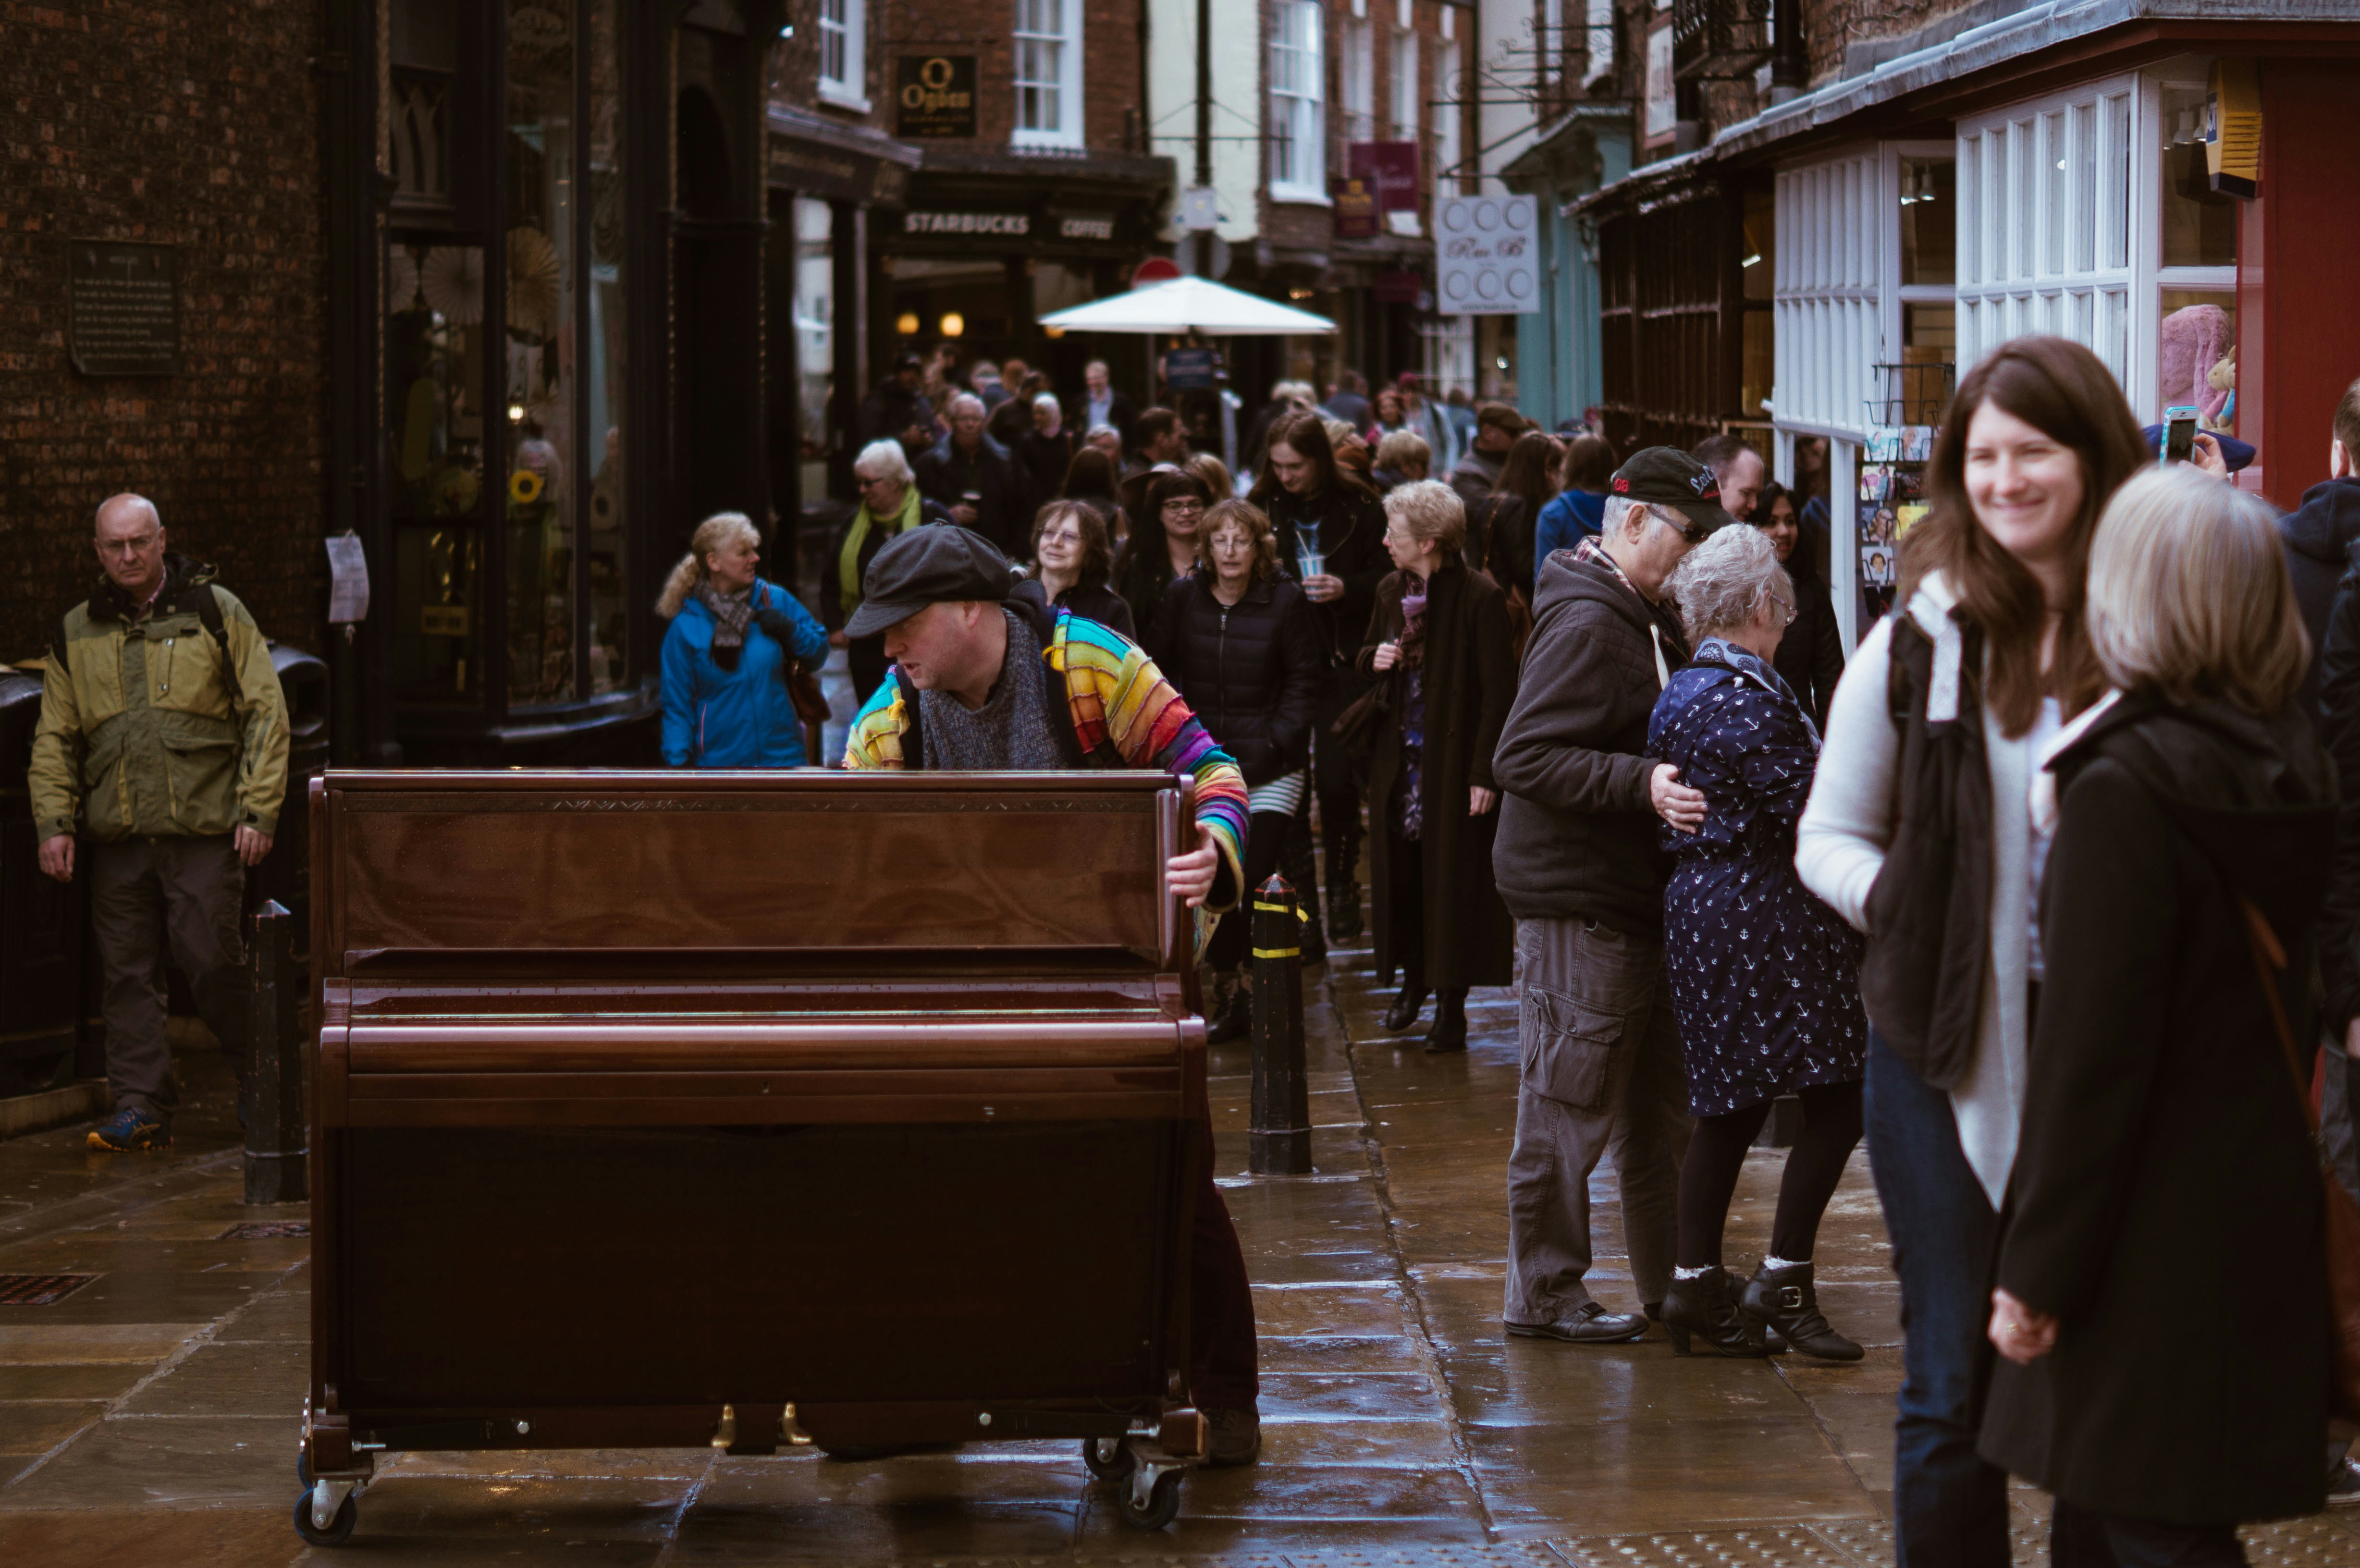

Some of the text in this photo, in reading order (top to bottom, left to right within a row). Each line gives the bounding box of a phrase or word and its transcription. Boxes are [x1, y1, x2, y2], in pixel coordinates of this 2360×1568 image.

[902, 85, 971, 113] Ogden
[905, 213, 1113, 240] STARBUCKS COFFEE
[1614, 478, 1629, 492] 08
